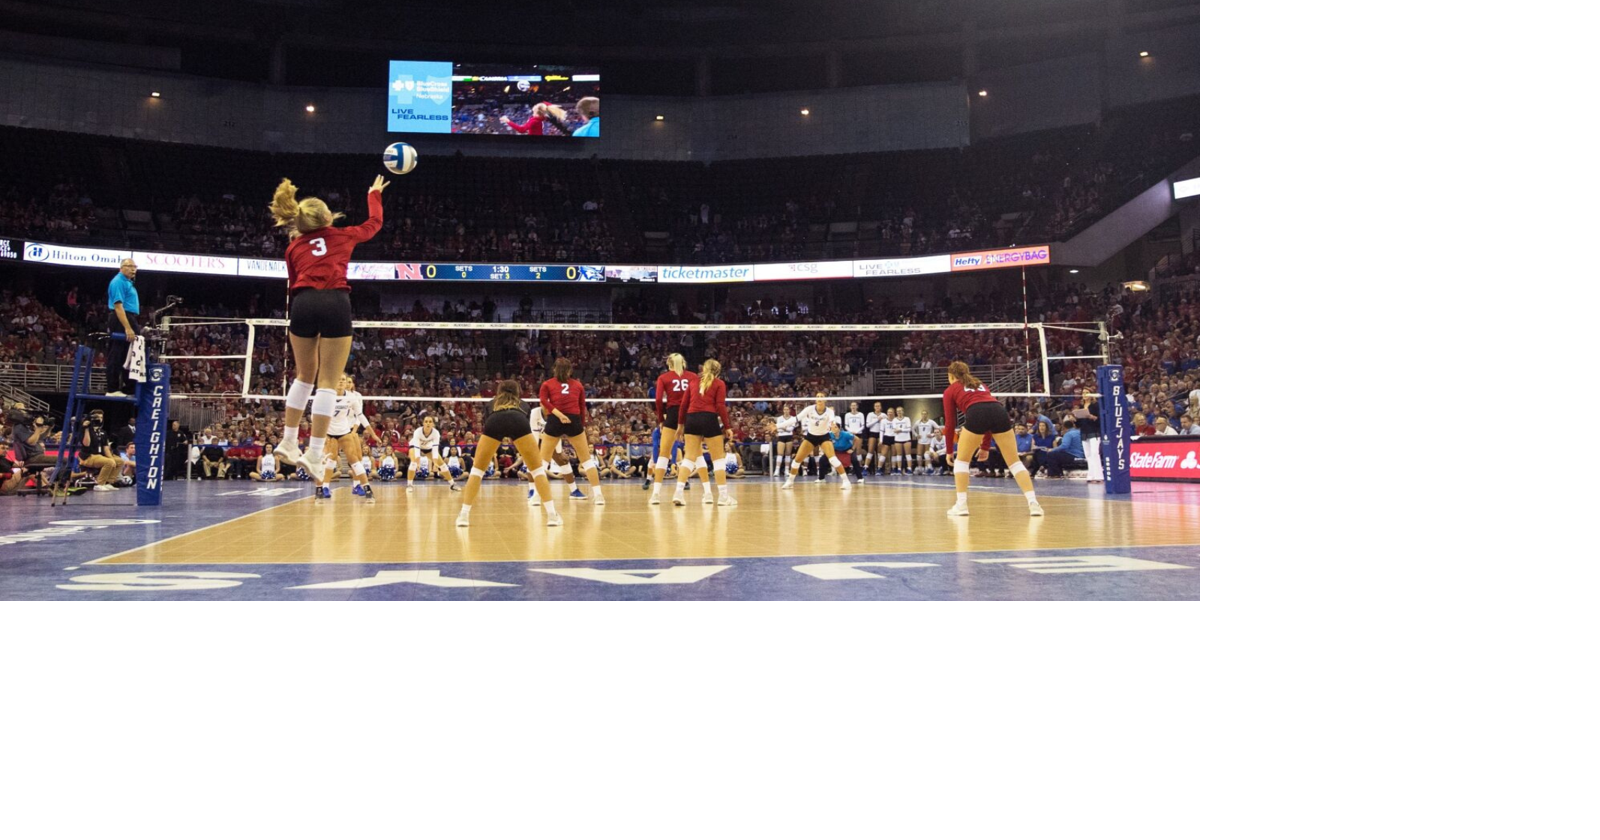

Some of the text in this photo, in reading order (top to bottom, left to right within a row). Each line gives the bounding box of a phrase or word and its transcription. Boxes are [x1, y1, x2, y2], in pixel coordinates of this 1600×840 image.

[309, 237, 327, 256] 3
[52, 250, 123, 264] Hilton Omah
[146, 253, 226, 269] SCOOTER'S
[955, 257, 980, 266] Hefty
[396, 263, 423, 280] N
[426, 265, 437, 278] 0
[566, 266, 576, 280] 0
[662, 265, 749, 279] ticketmaster
[797, 262, 818, 273] csg
[866, 267, 921, 276] FEARLESS
[561, 383, 570, 394] 2
[672, 379, 689, 392] 26
[1112, 385, 1125, 470] BLUEJAYS
[146, 385, 164, 490] CREIGHTON
